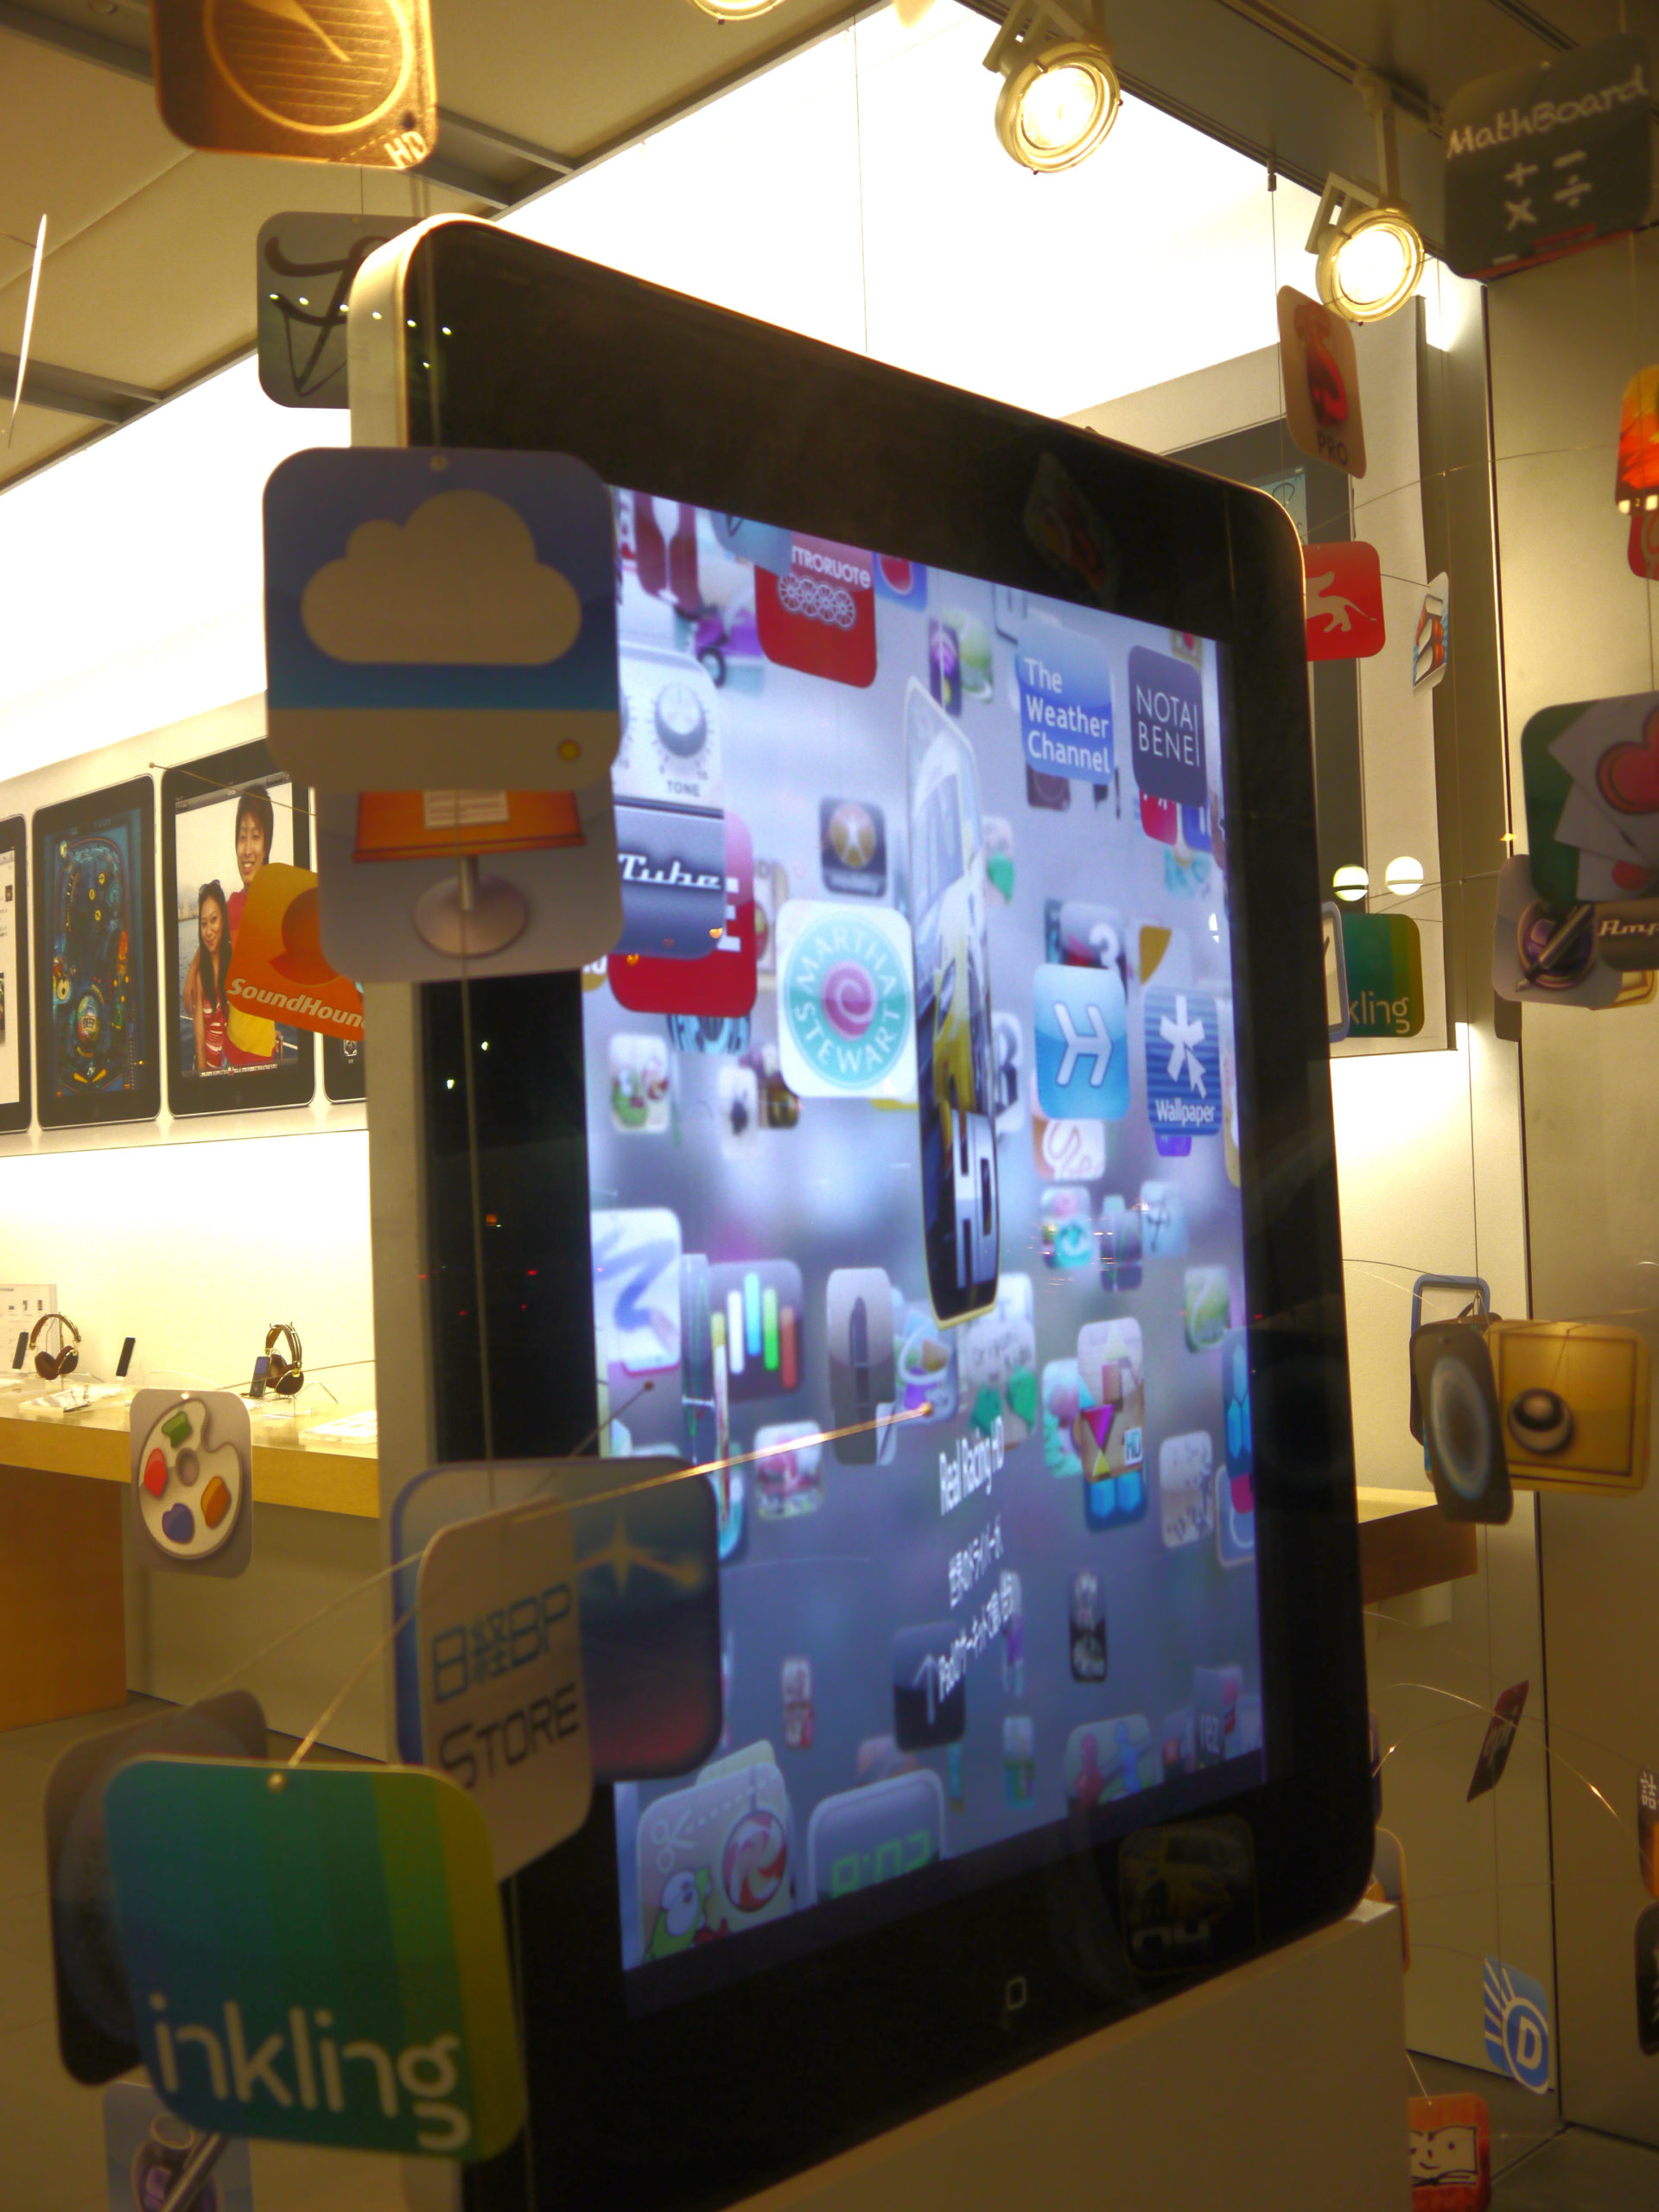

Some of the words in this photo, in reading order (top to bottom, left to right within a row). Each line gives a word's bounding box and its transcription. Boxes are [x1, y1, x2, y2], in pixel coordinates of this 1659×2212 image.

[1446, 64, 1649, 160] MathBoard
[384, 130, 428, 169] HD
[1316, 431, 1350, 467] PRO
[1023, 657, 1063, 694] The
[1026, 694, 1109, 739] Weather
[1136, 683, 1194, 732] NOTA
[1027, 730, 1110, 774] Channel
[1138, 721, 1194, 766] BENE
[666, 779, 702, 798] TONE
[617, 852, 722, 890] Tube
[795, 925, 897, 996] MARTHA
[226, 977, 364, 1029] SoundHoun
[1349, 990, 1411, 1034] kling
[794, 1001, 901, 1074] STEWART
[1154, 1097, 1216, 1128] Wallpaper
[938, 1452, 962, 1516] Real
[961, 1427, 993, 1497] Racing
[438, 1681, 580, 1792] STORE
[1639, 1770, 1659, 1810] 詰
[148, 1990, 472, 2151] inkling
